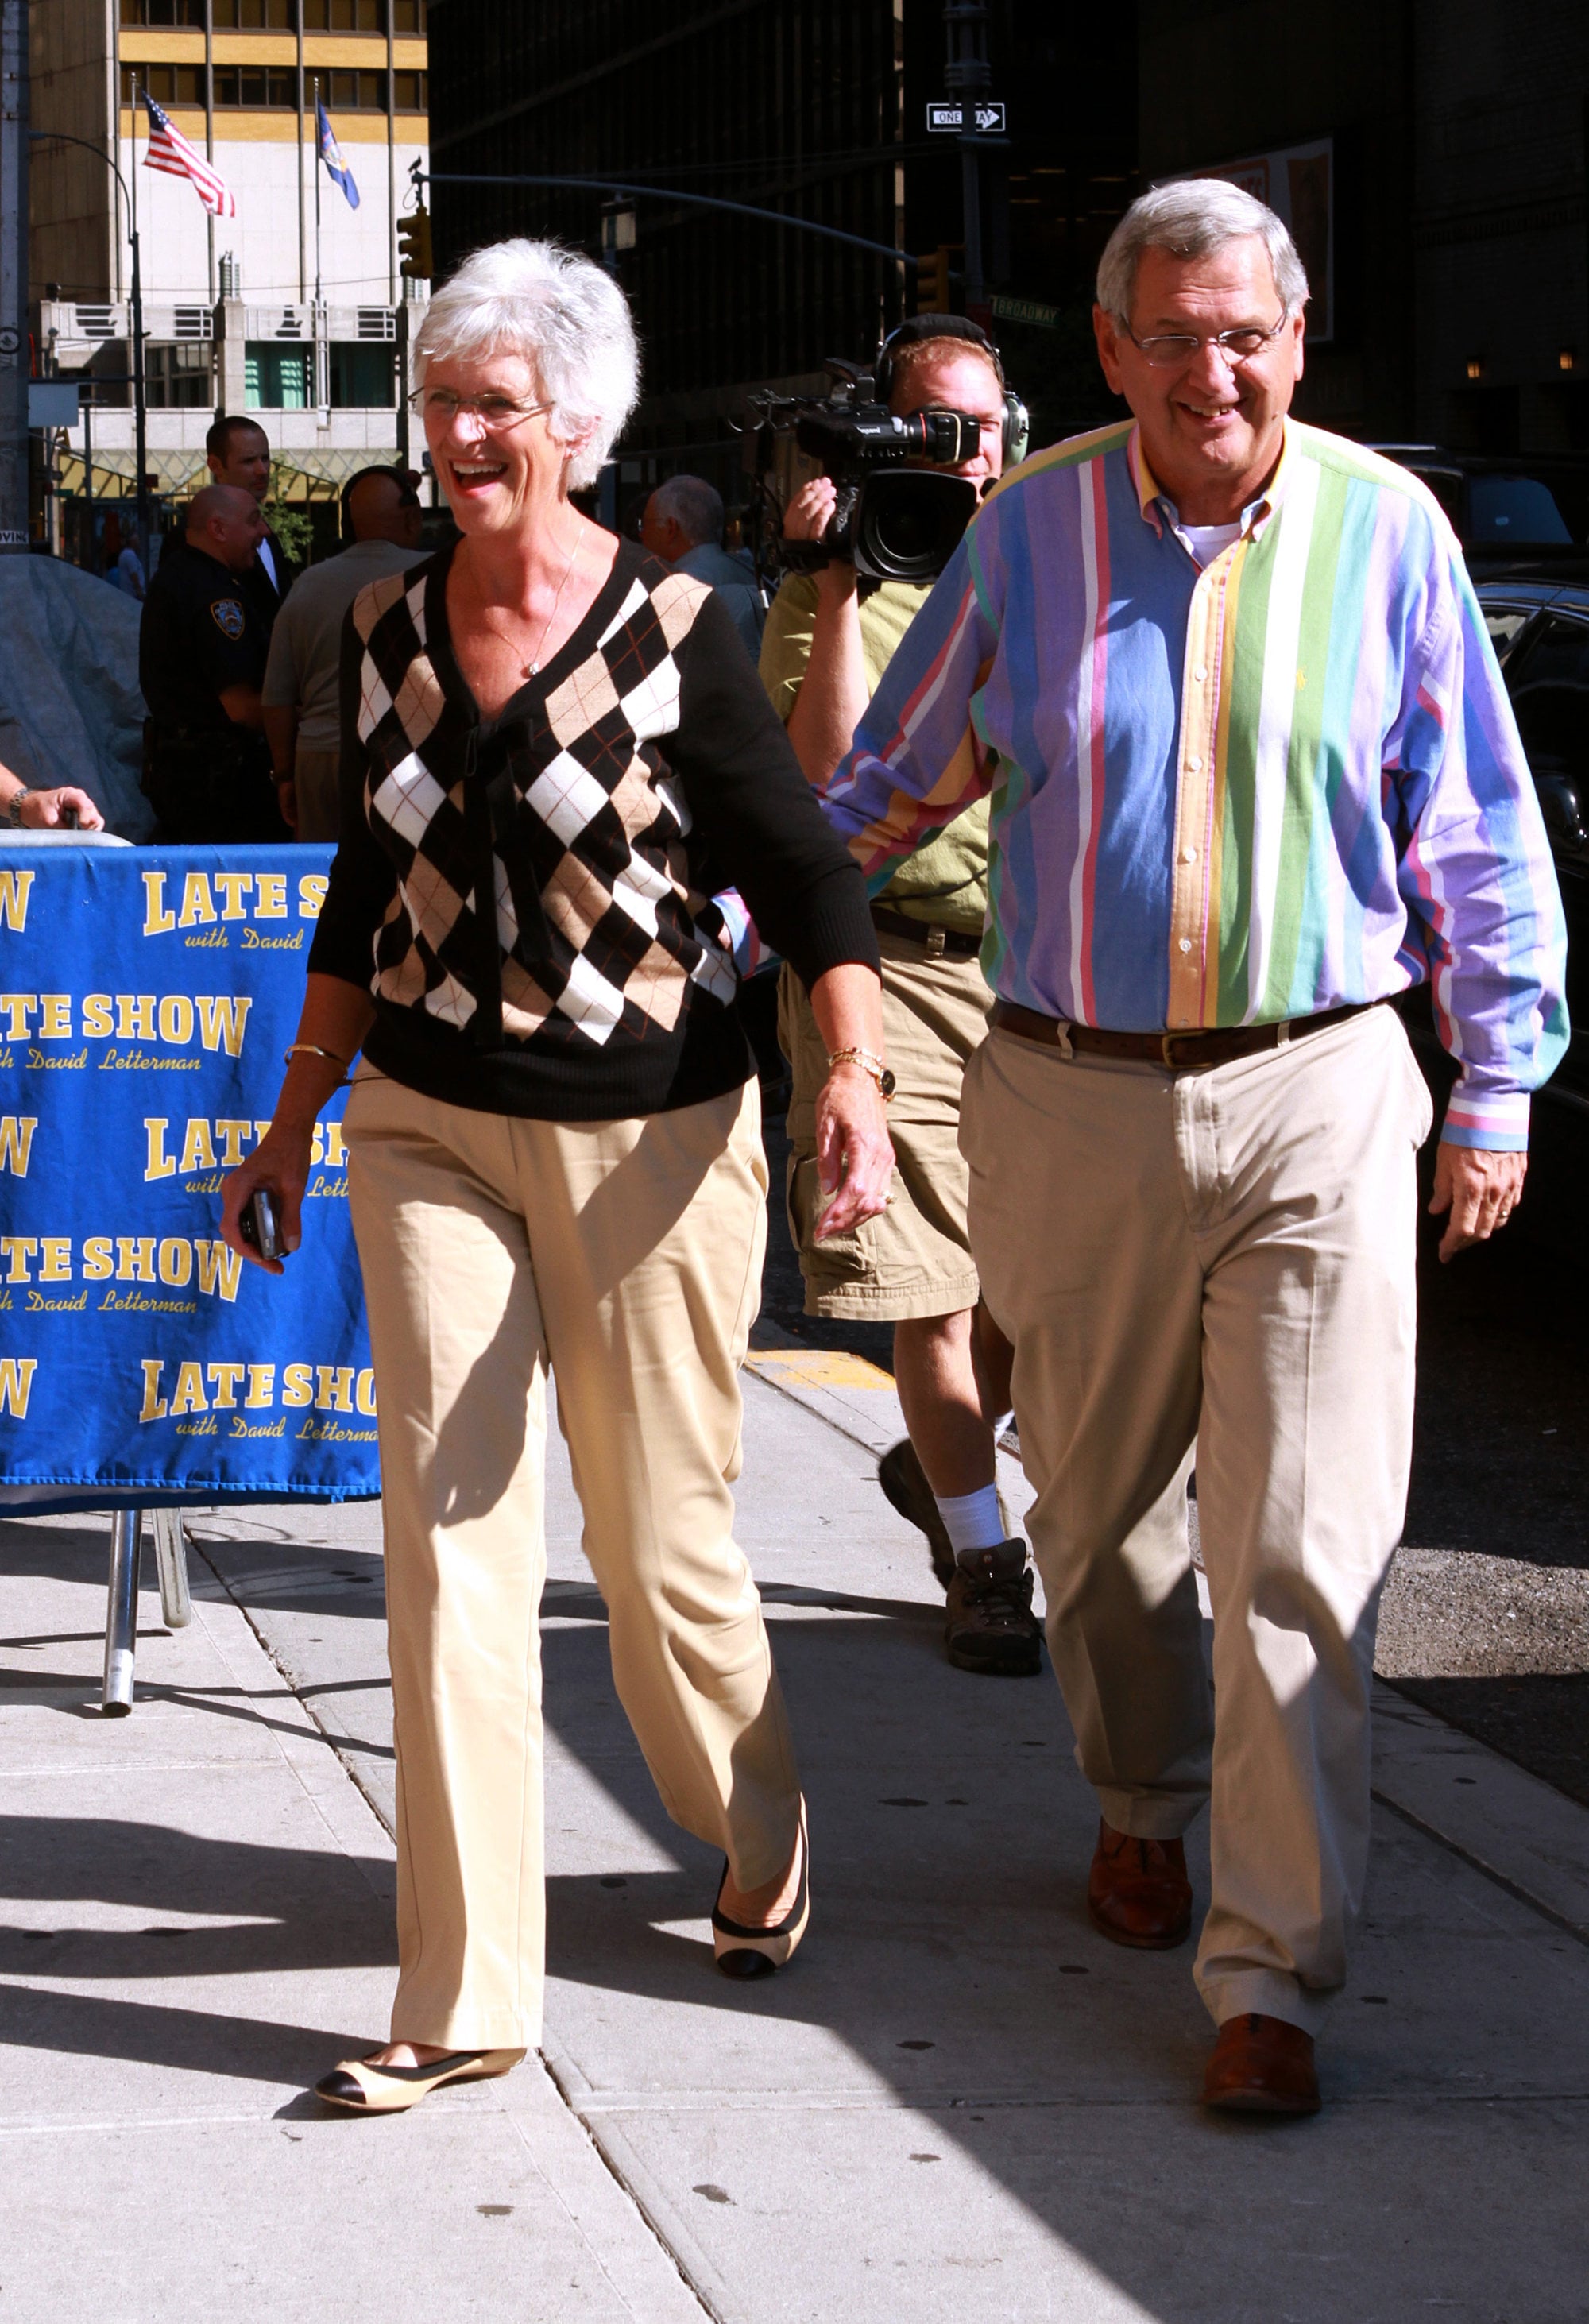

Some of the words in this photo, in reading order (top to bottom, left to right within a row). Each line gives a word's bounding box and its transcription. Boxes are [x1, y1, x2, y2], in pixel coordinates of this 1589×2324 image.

[939, 112, 961, 122] ONE
[975, 112, 992, 123] AY
[999, 299, 1057, 324] BROADWAY
[141, 872, 288, 937] LATE
[184, 927, 229, 949] with
[241, 928, 303, 950] David
[0, 994, 72, 1042] TE
[82, 993, 252, 1058] SHOW
[25, 1046, 87, 1069] David
[98, 1049, 201, 1071] Letterman
[0, 1236, 72, 1283] TE
[83, 1237, 243, 1303] SHOW
[25, 1290, 87, 1312] David
[97, 1290, 198, 1313] Letterman
[139, 1359, 276, 1423] LATE
[282, 1363, 377, 1417] SHO
[176, 1415, 218, 1437] with
[228, 1417, 284, 1438] David
[295, 1418, 379, 1442] Letterma
